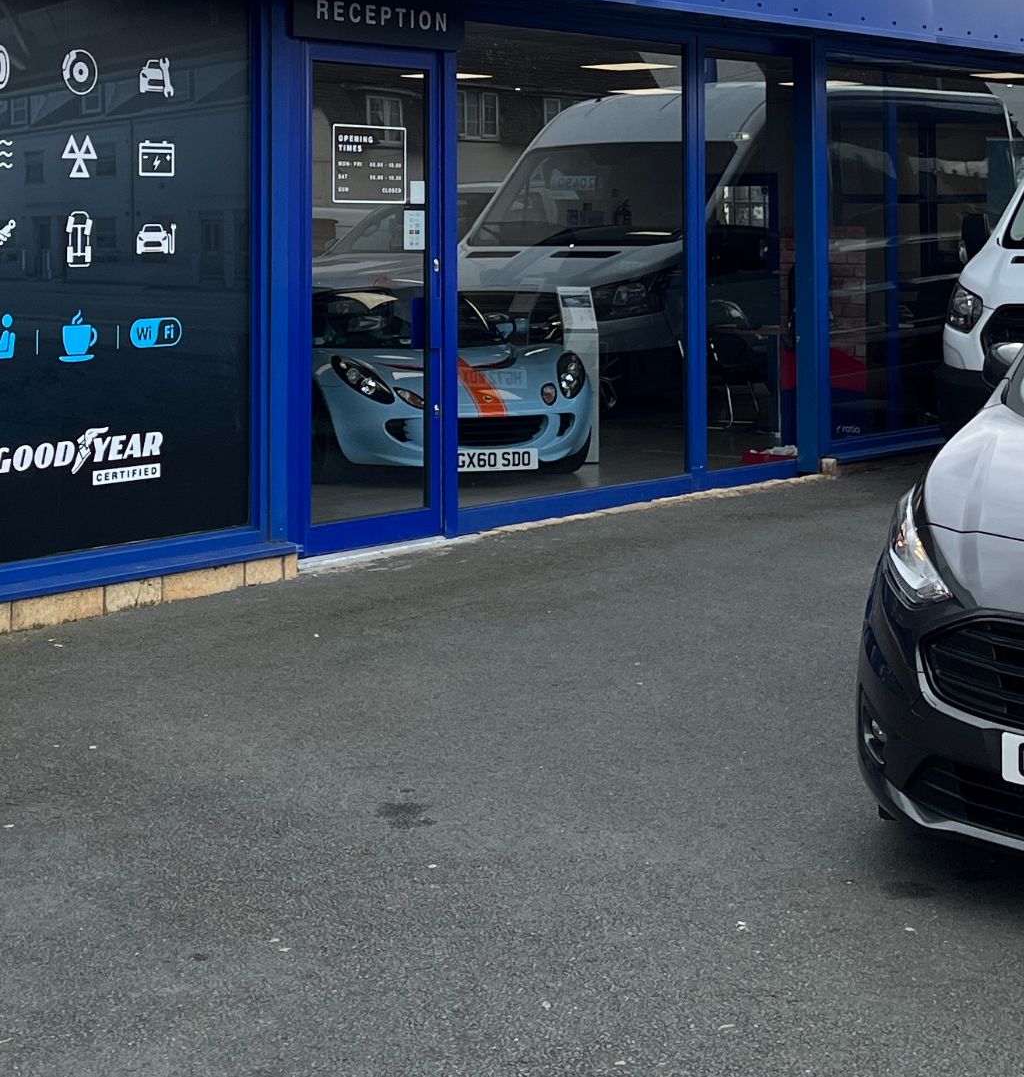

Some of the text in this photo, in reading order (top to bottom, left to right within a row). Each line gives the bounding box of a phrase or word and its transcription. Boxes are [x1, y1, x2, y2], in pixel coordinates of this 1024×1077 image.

[316, 0, 447, 32] RECEPTION
[338, 134, 373, 143] OPENING
[338, 144, 362, 152] TIMES
[0, 431, 163, 473] GOODYEAR
[457, 451, 531, 468] GX60 SDO
[96, 466, 157, 482] CERTIFIED
